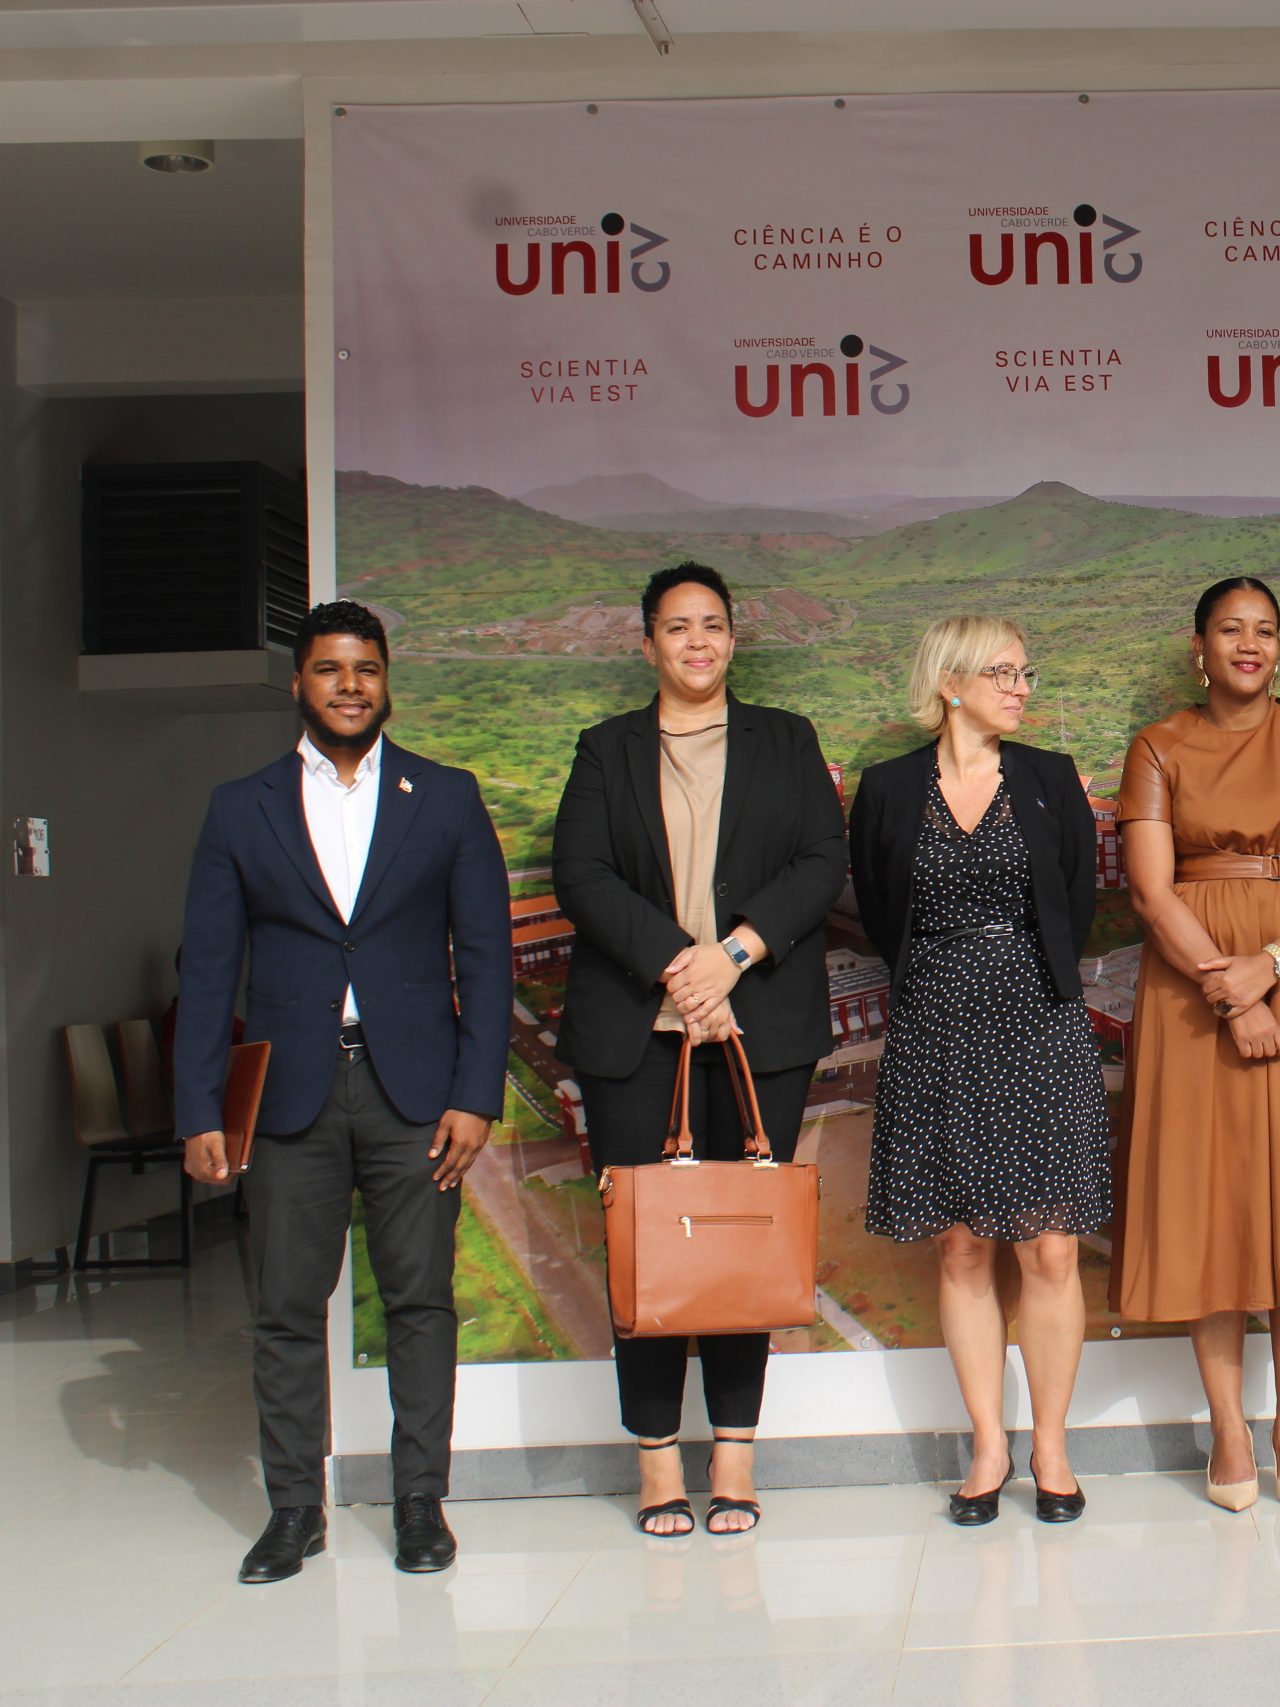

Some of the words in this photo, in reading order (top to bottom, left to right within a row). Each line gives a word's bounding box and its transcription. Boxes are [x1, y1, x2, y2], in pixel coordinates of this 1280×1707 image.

[968, 207, 1049, 217] UNIVERSIDADE
[495, 215, 577, 227] UNIVERSIDADE
[1000, 218, 1032, 228] CABO
[1033, 217, 1068, 227] VERDE
[527, 227, 559, 237] CABO
[560, 226, 596, 236] VERDE
[734, 224, 844, 247] CIÊNCIA
[859, 222, 870, 244] É
[886, 226, 902, 244] O
[754, 251, 883, 271] CAMINHO
[734, 337, 815, 348] UNIVERSIDADE
[1237, 340, 1269, 350] CABO
[766, 349, 798, 359] CABO
[799, 348, 835, 358] VERDE
[995, 349, 1122, 368] SCIENTIA
[521, 358, 648, 379] SCIENTIA
[1005, 375, 1050, 393] VIA
[1065, 374, 1112, 392] EST
[530, 386, 576, 403] VIA
[590, 384, 639, 402] EST
